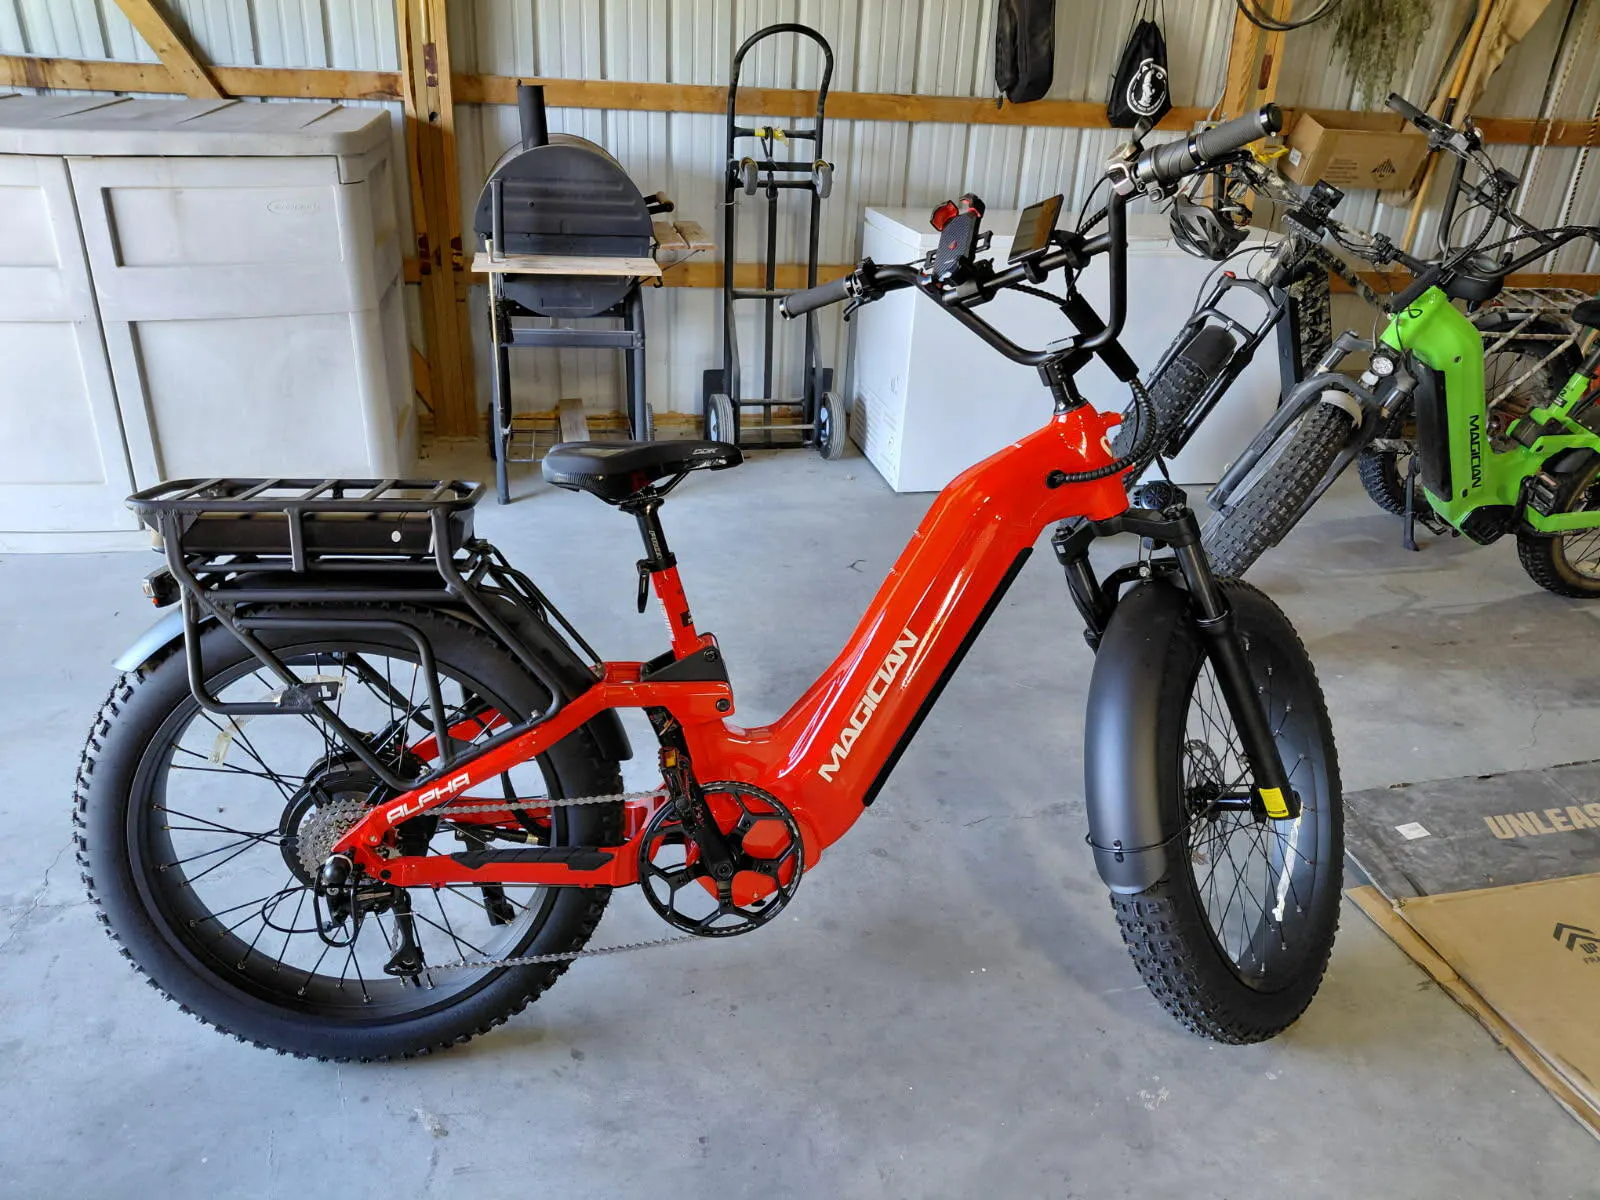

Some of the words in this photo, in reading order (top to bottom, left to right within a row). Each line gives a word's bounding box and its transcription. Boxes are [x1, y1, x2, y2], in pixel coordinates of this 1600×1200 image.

[1469, 414, 1482, 489] MAGICIAN
[817, 627, 919, 784] MAGICIAN
[386, 772, 471, 825] ALPHA
